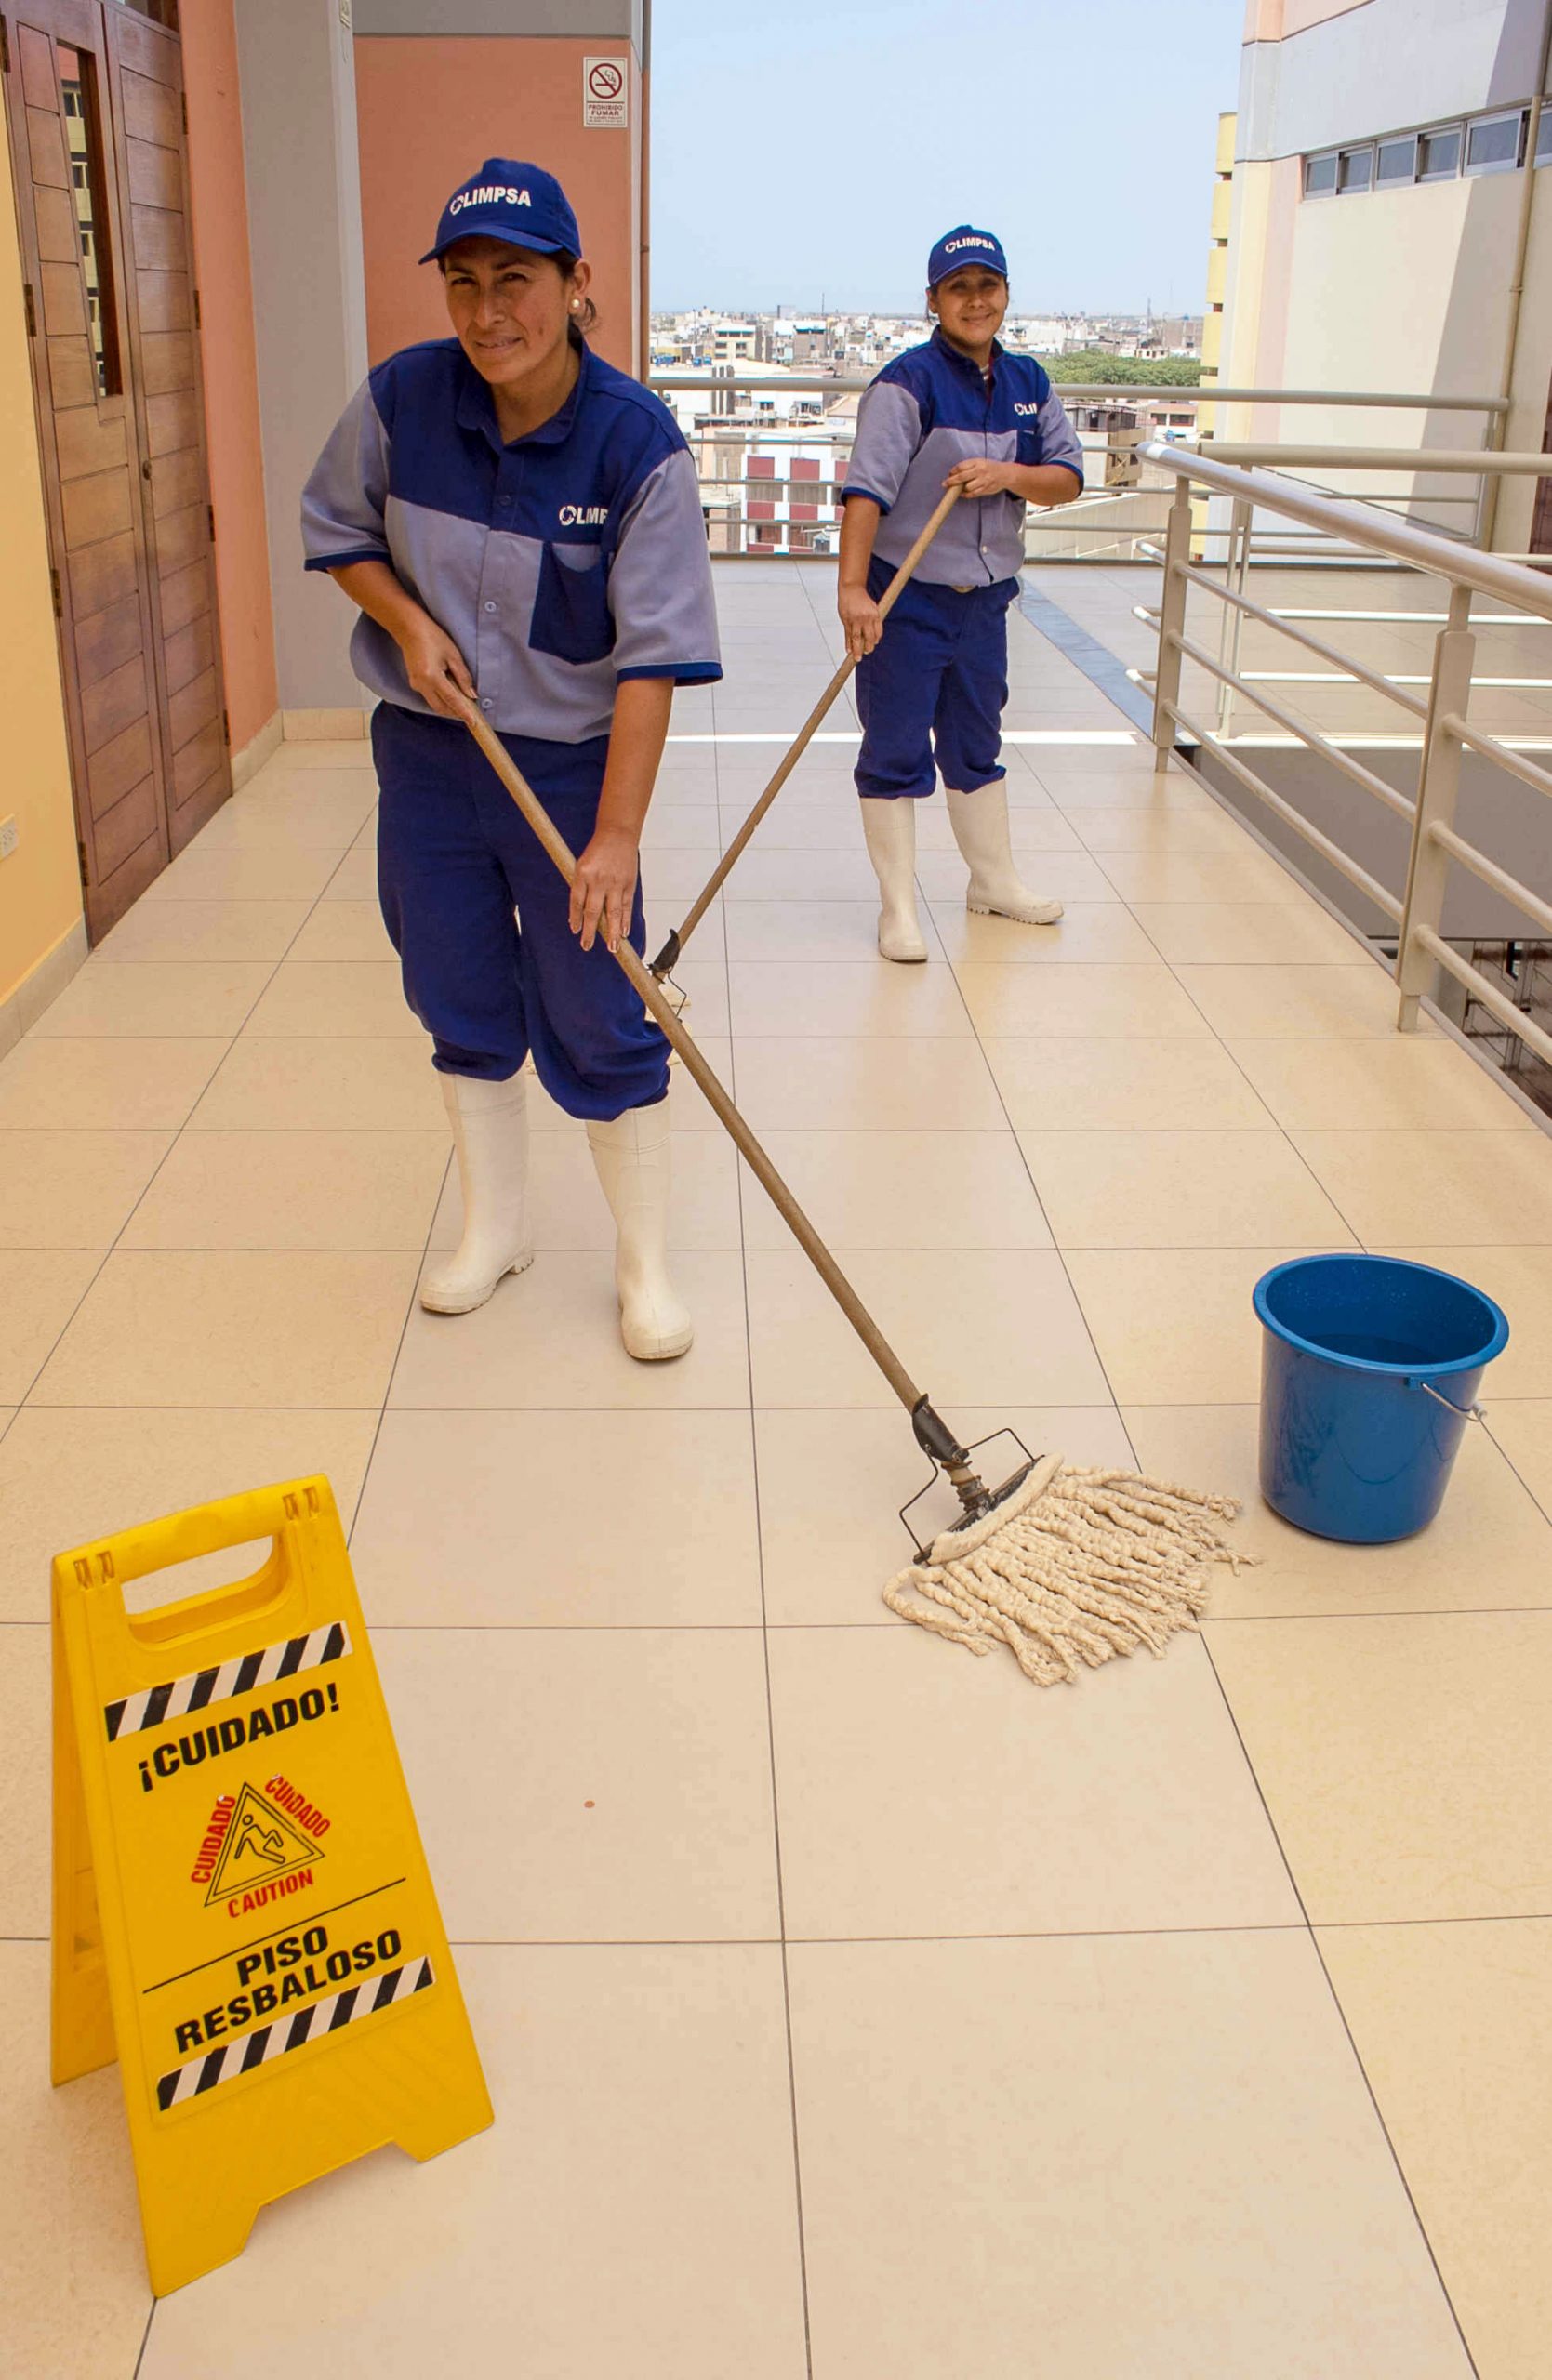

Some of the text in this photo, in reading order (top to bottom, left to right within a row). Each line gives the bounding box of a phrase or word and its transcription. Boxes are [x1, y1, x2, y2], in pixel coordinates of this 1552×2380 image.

[449, 186, 532, 216] OLIMPSA
[945, 236, 996, 254] OLIMPSA
[138, 1682, 340, 1793] ¡CUIDADO!
[264, 1773, 331, 1838] CUIDADO
[191, 1795, 236, 1884] CUIDADO
[227, 1868, 313, 1919] CAUTION
[236, 1925, 329, 1988] PISO
[174, 1929, 403, 2055] RESBALOSO
